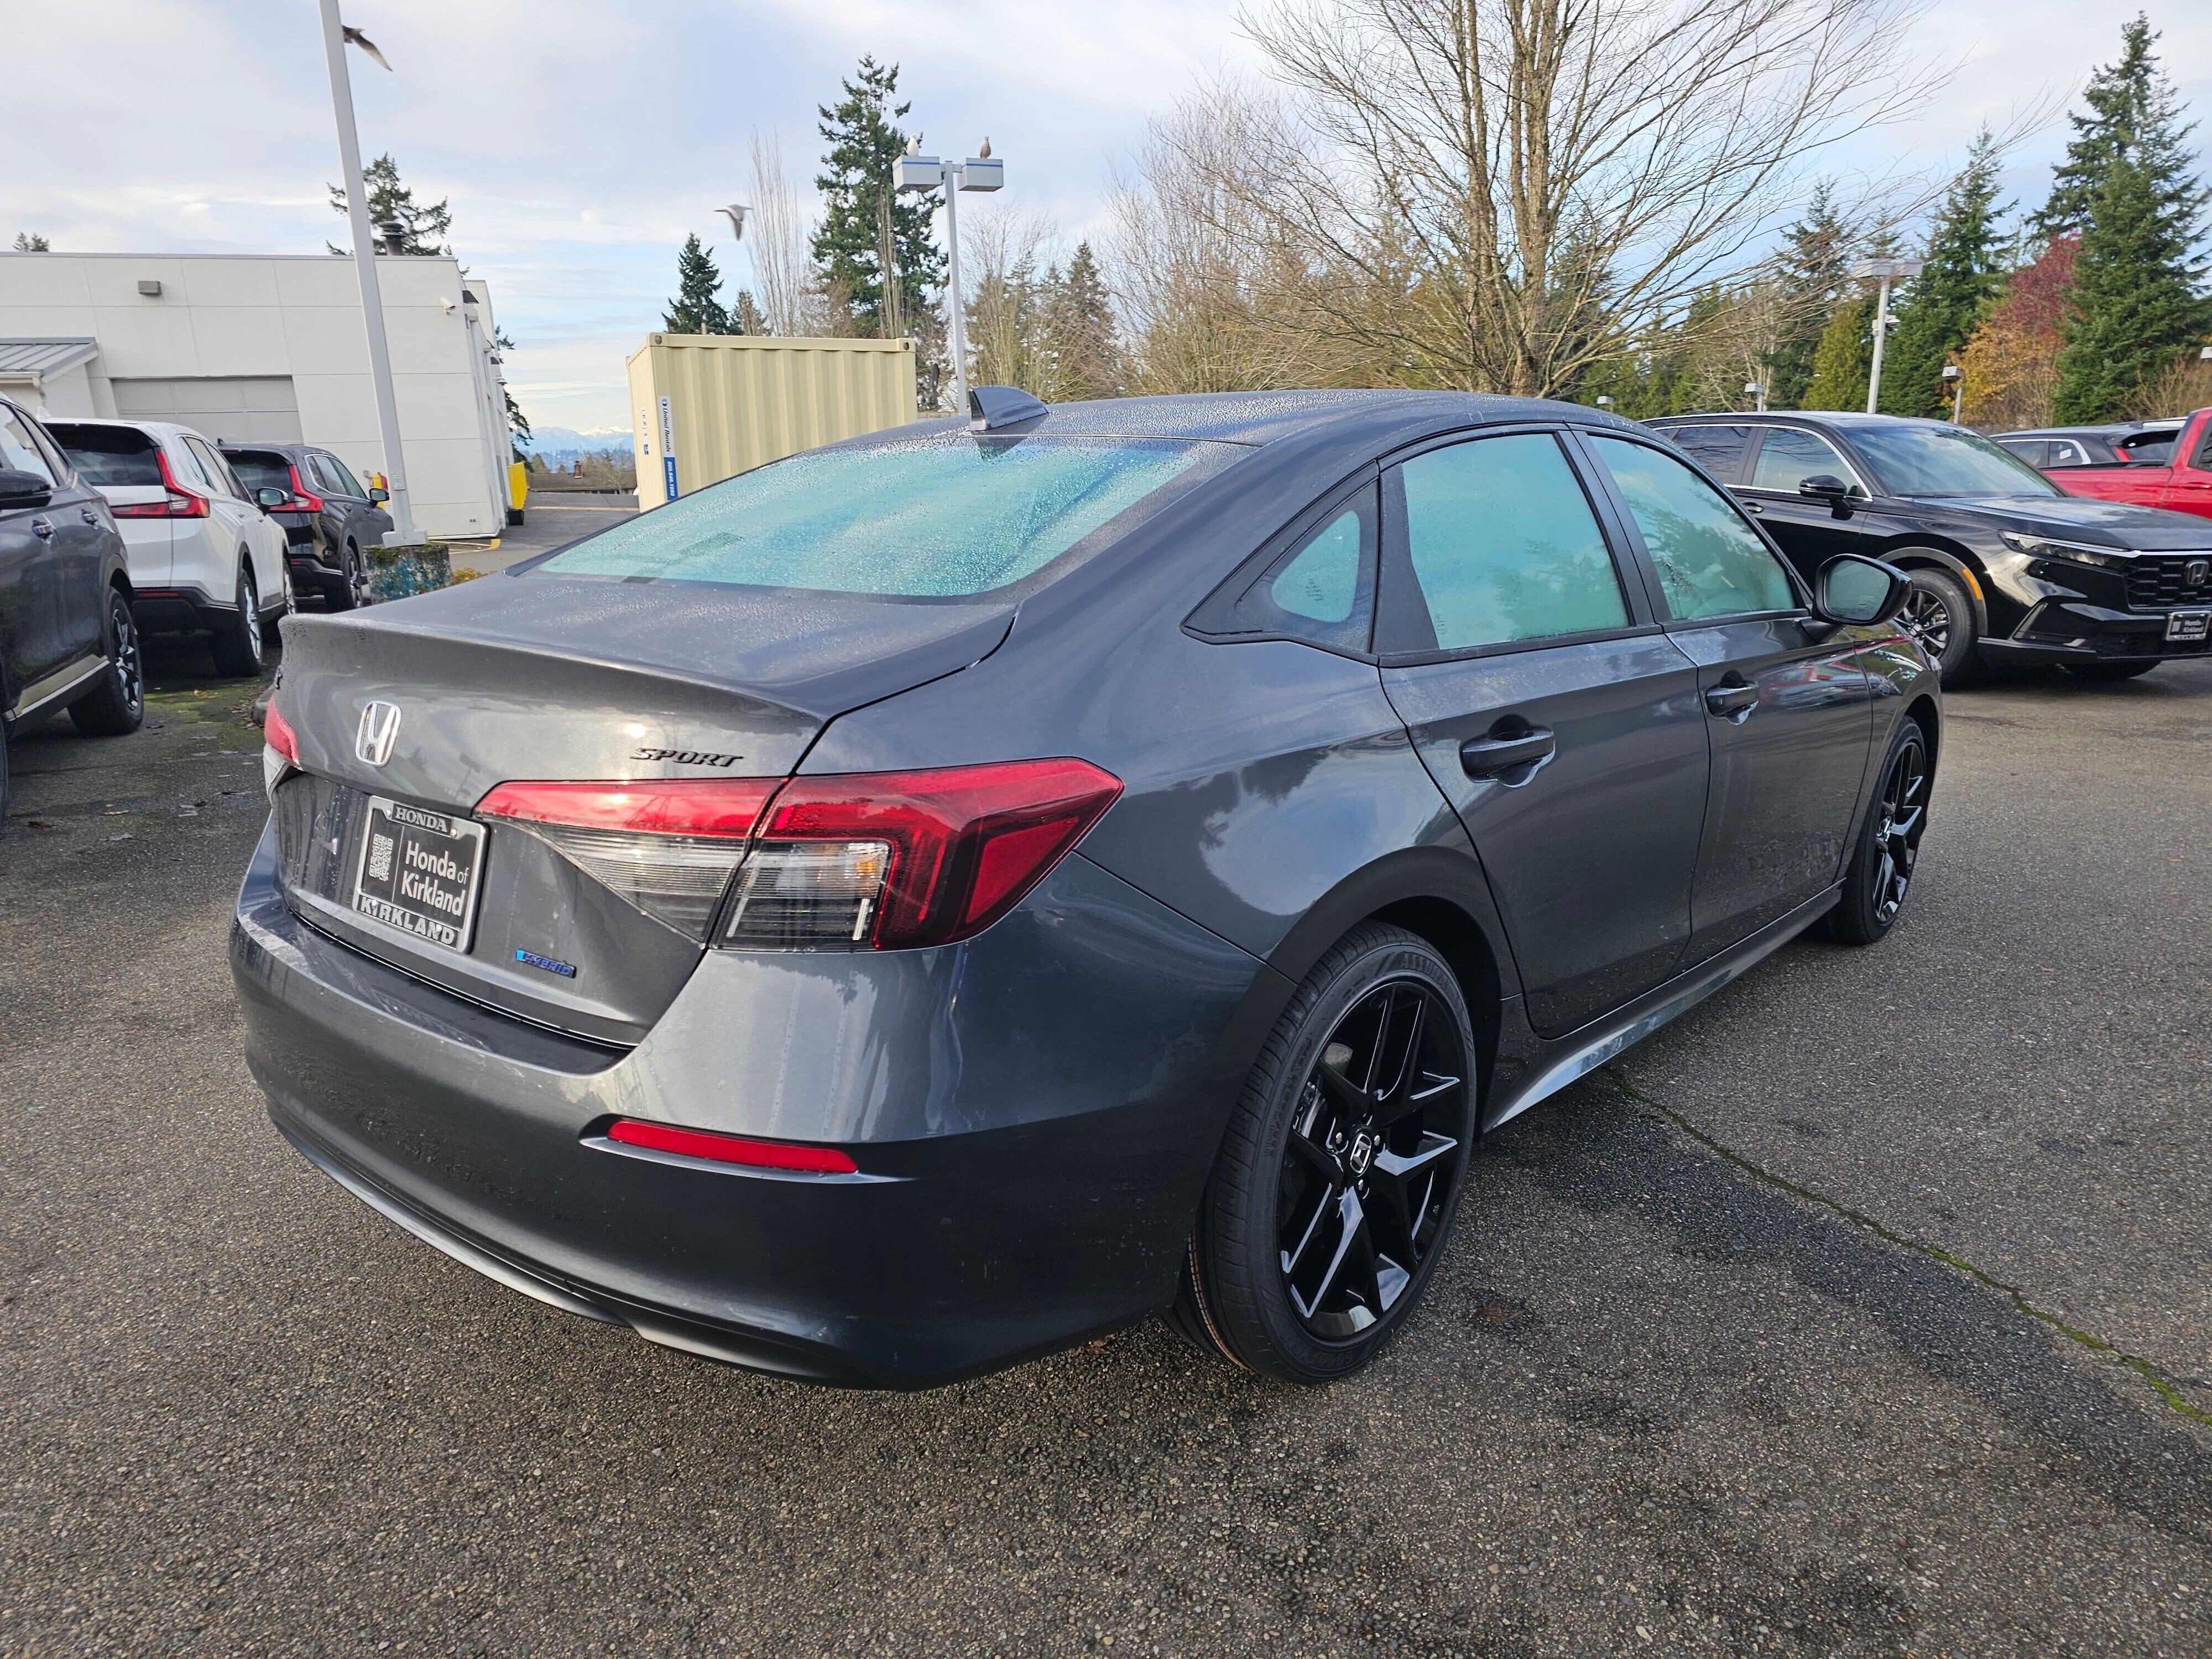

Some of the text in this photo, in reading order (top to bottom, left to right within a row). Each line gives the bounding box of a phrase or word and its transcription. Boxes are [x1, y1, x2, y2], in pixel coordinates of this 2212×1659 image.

[630, 748, 744, 768] SPORT
[395, 806, 448, 833] HONDA
[405, 840, 469, 885] Honda of
[401, 870, 466, 916] Kirkland
[360, 896, 455, 945] KIRKLAND
[525, 953, 572, 975] HYBRID
